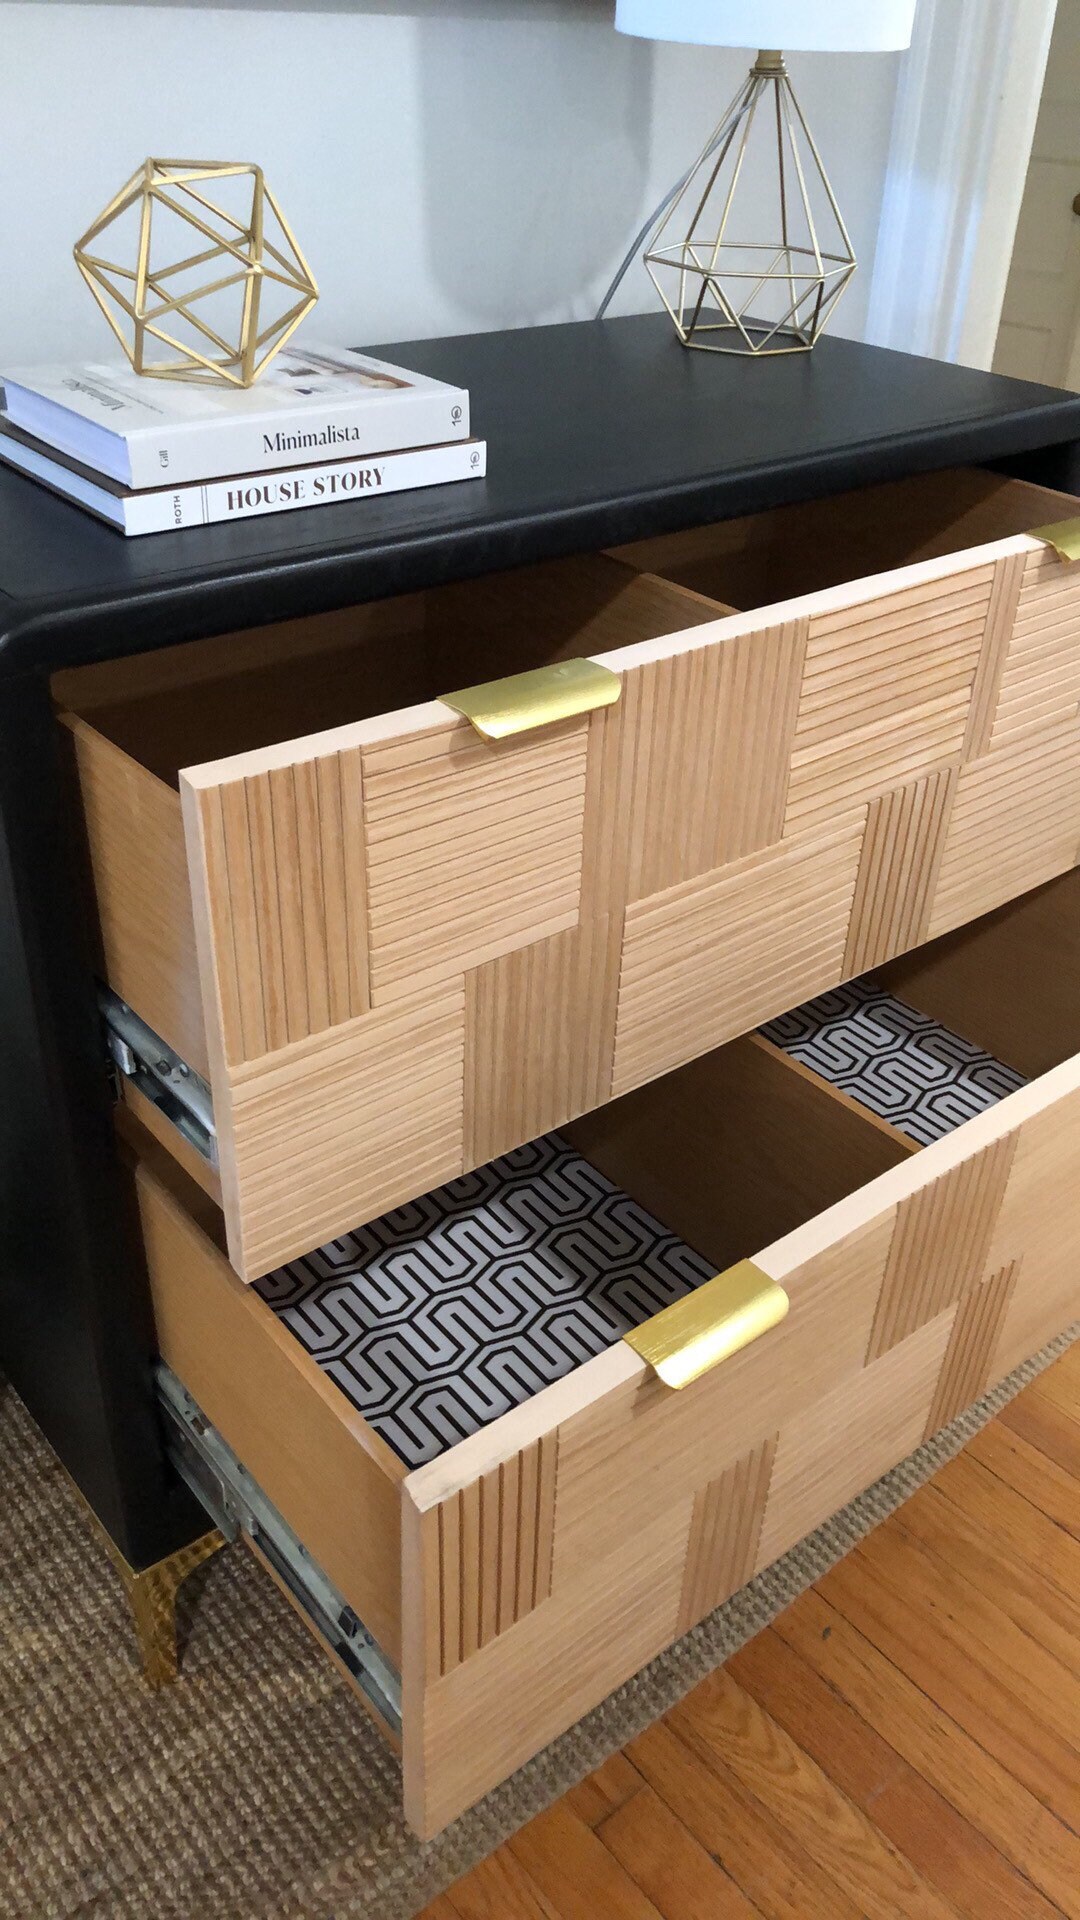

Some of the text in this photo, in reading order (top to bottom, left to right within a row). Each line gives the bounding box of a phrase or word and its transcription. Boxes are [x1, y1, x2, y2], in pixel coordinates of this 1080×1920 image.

[263, 425, 361, 453] Minimalista
[159, 450, 169, 468] Gill
[227, 466, 385, 511] HOUSE STORY
[174, 495, 182, 525] ROTH
